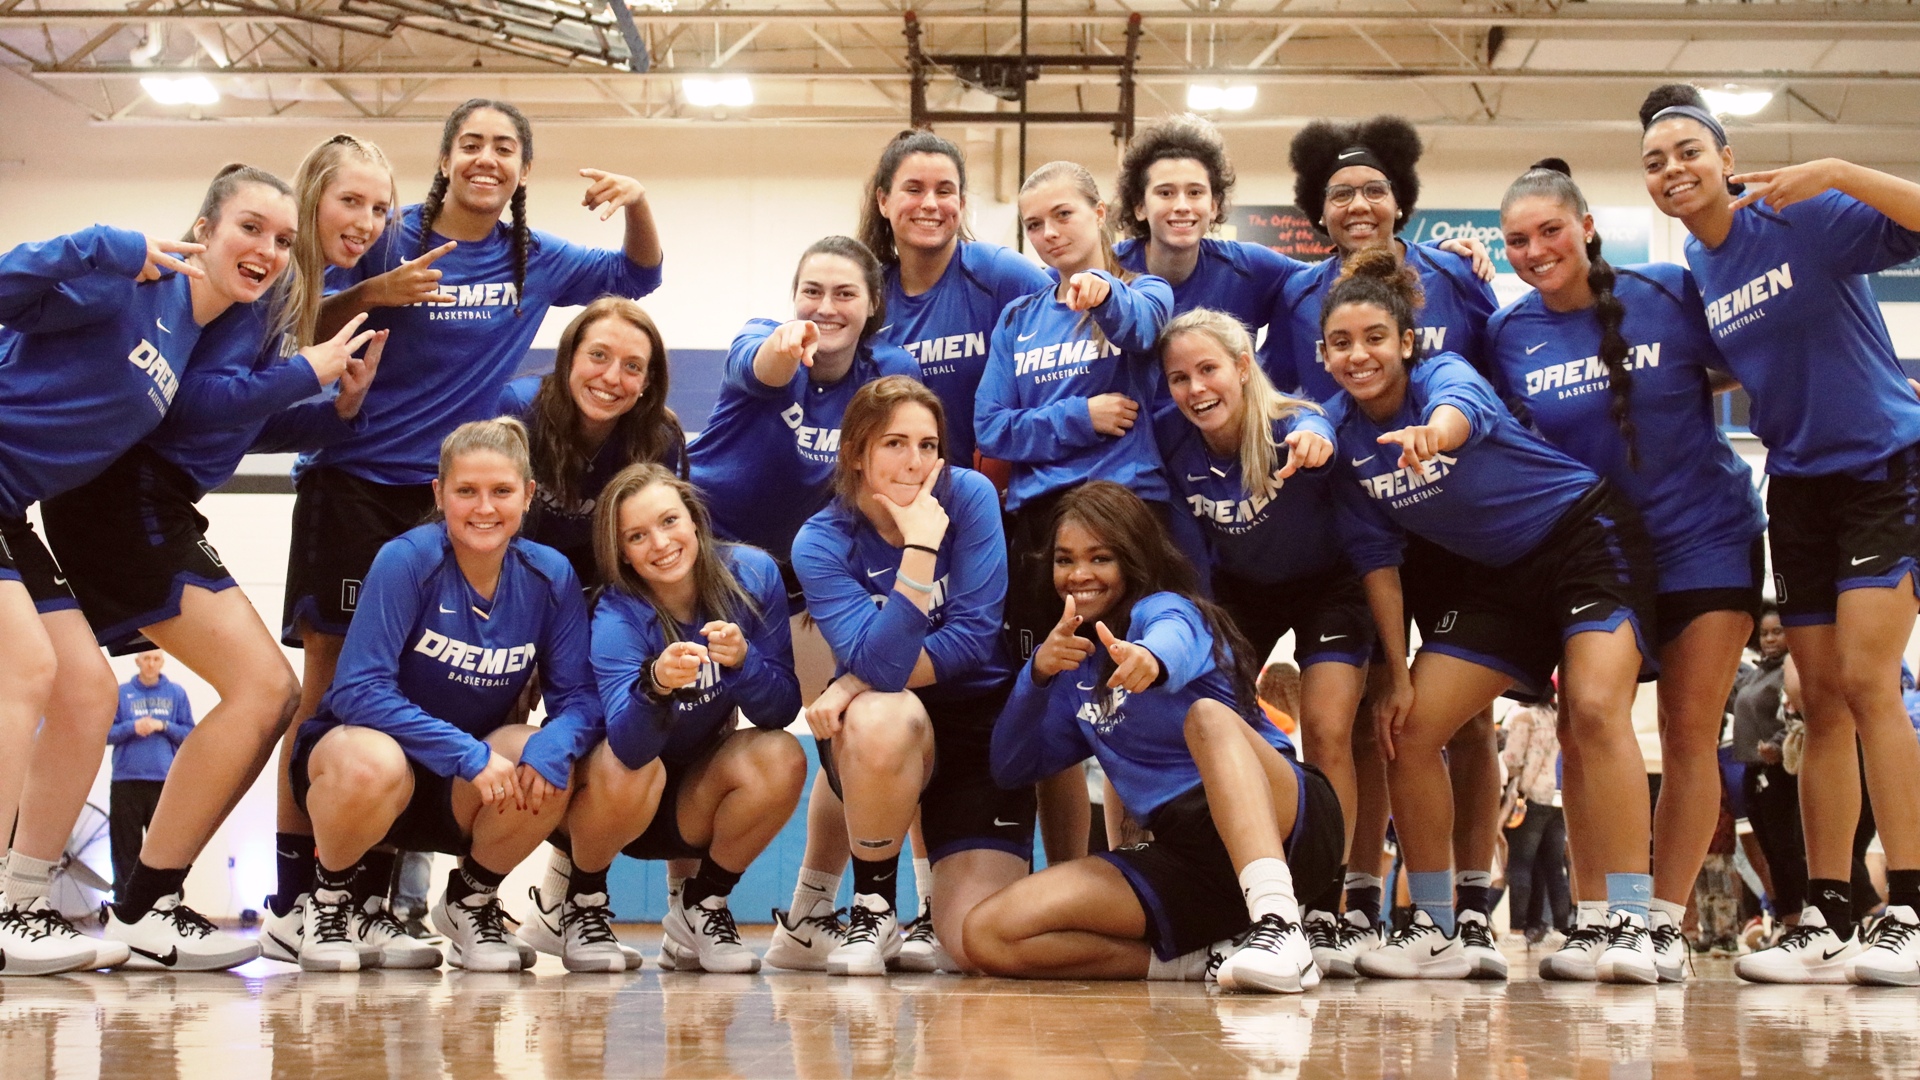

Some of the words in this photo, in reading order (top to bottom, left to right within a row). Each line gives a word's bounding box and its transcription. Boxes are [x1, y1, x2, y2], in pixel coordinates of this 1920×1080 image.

[1431, 221, 1504, 246] Orthop
[1705, 262, 1794, 334] AEMEN
[429, 310, 492, 320] BASKETBALL
[1718, 308, 1766, 339] BASKETBALL
[898, 330, 985, 365] EMEN
[128, 338, 179, 406] DAEM
[922, 364, 956, 377] ETBALL
[1034, 365, 1091, 385] BASKETBALL
[1391, 485, 1444, 510] BASKETBALL
[413, 627, 537, 675] DAEMEN
[448, 671, 510, 687] BASKETBALL
